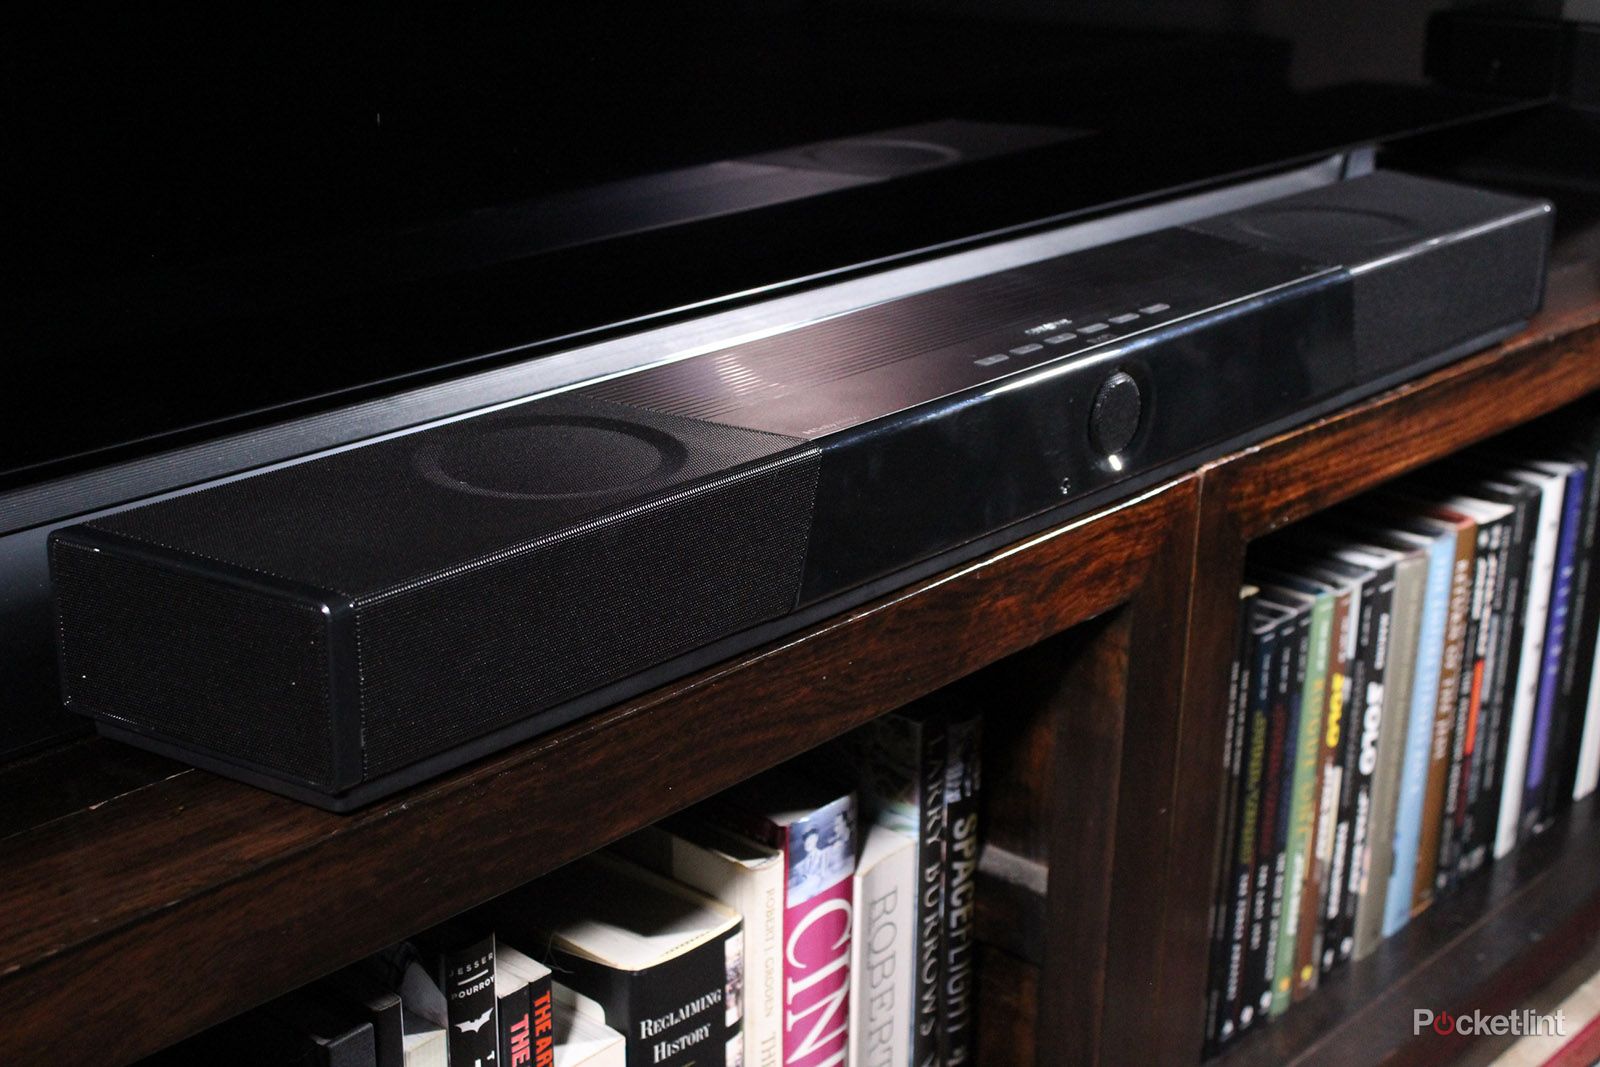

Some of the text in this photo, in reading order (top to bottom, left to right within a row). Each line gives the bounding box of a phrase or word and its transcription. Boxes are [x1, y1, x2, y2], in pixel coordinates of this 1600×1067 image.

[947, 812, 978, 1033] SPACEFLIGHT
[449, 952, 494, 977] JESSER
[786, 898, 852, 1067] CIN
[452, 975, 495, 1000] POURROY
[534, 991, 552, 1036] THE
[640, 988, 721, 1039] RECLAIMING
[653, 1022, 711, 1064] HISTORY
